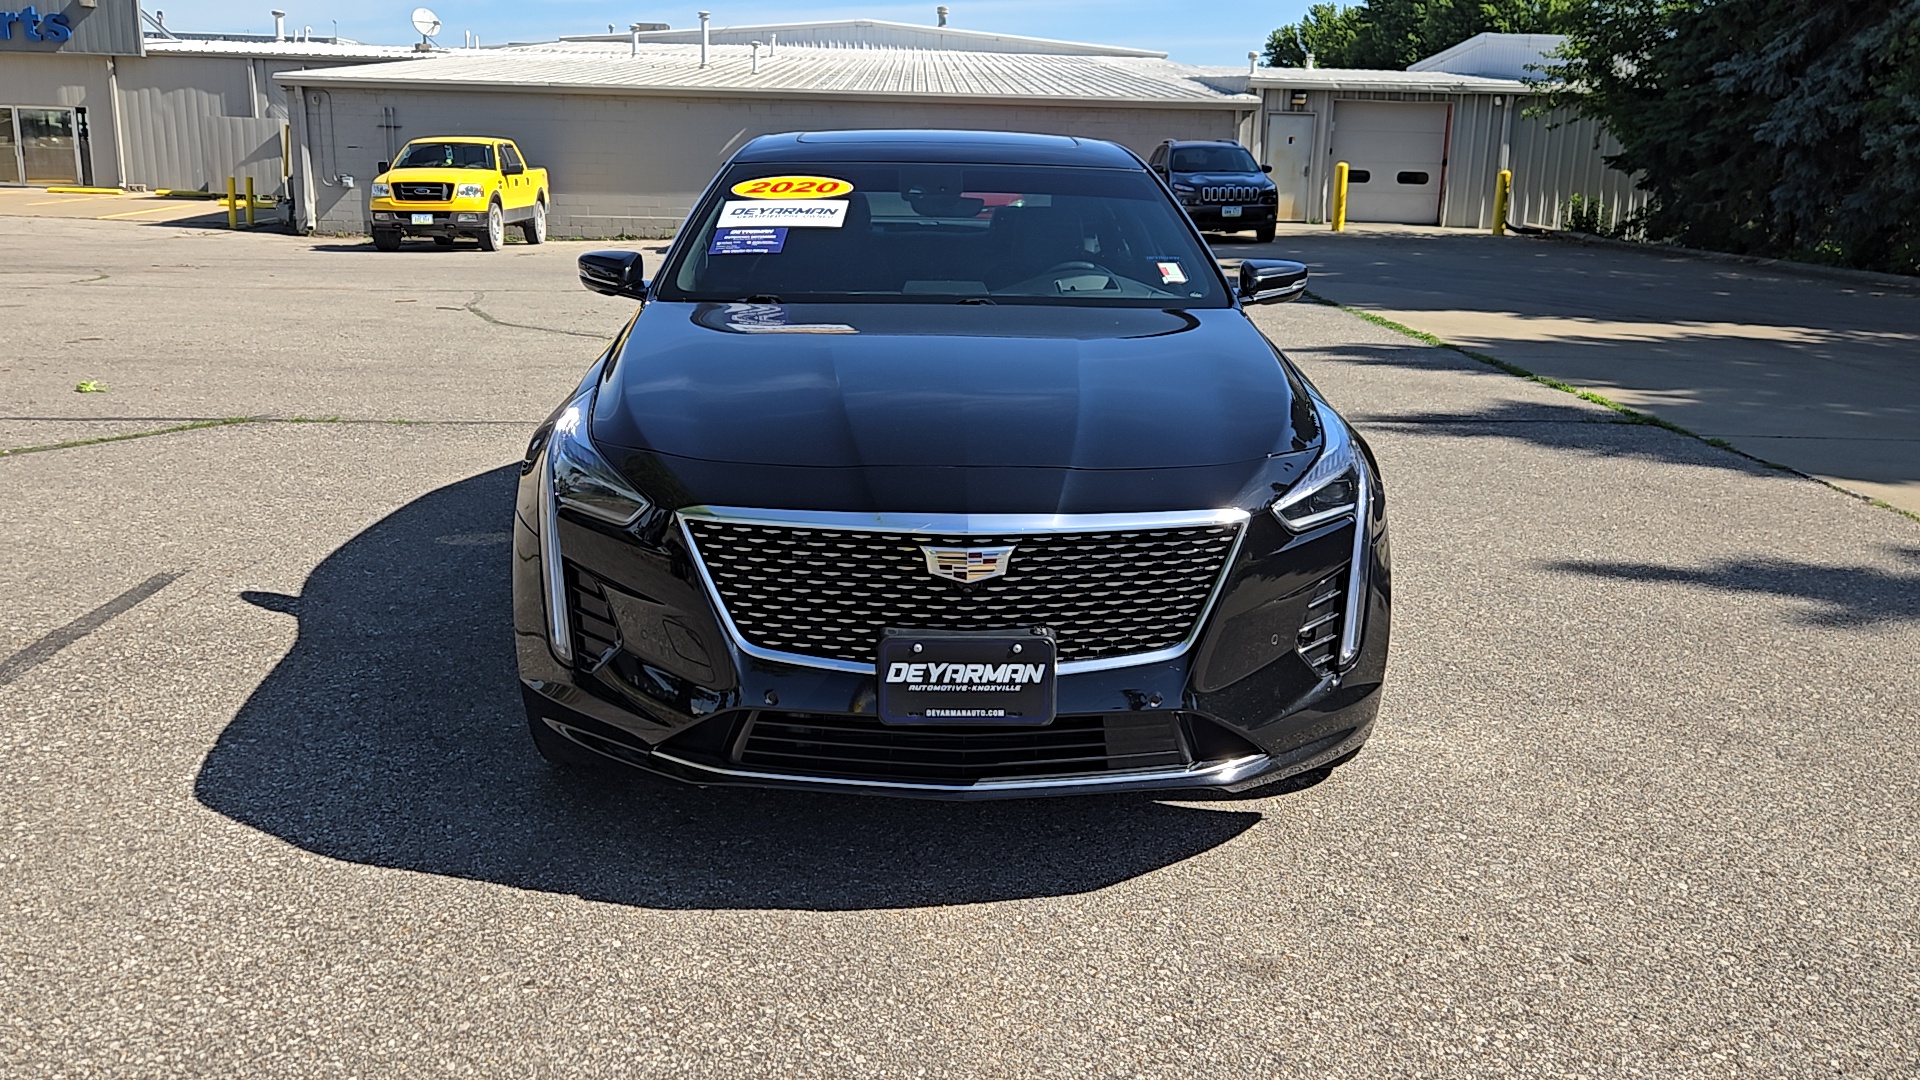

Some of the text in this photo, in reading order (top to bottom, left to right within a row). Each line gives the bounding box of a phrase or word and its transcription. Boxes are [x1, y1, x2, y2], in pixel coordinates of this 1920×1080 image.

[744, 181, 840, 194] 2020
[729, 207, 840, 216] DEYARMAN
[885, 662, 1046, 684] DEYARMAN
[925, 708, 1005, 718] DEYARMANAUTO.COM
